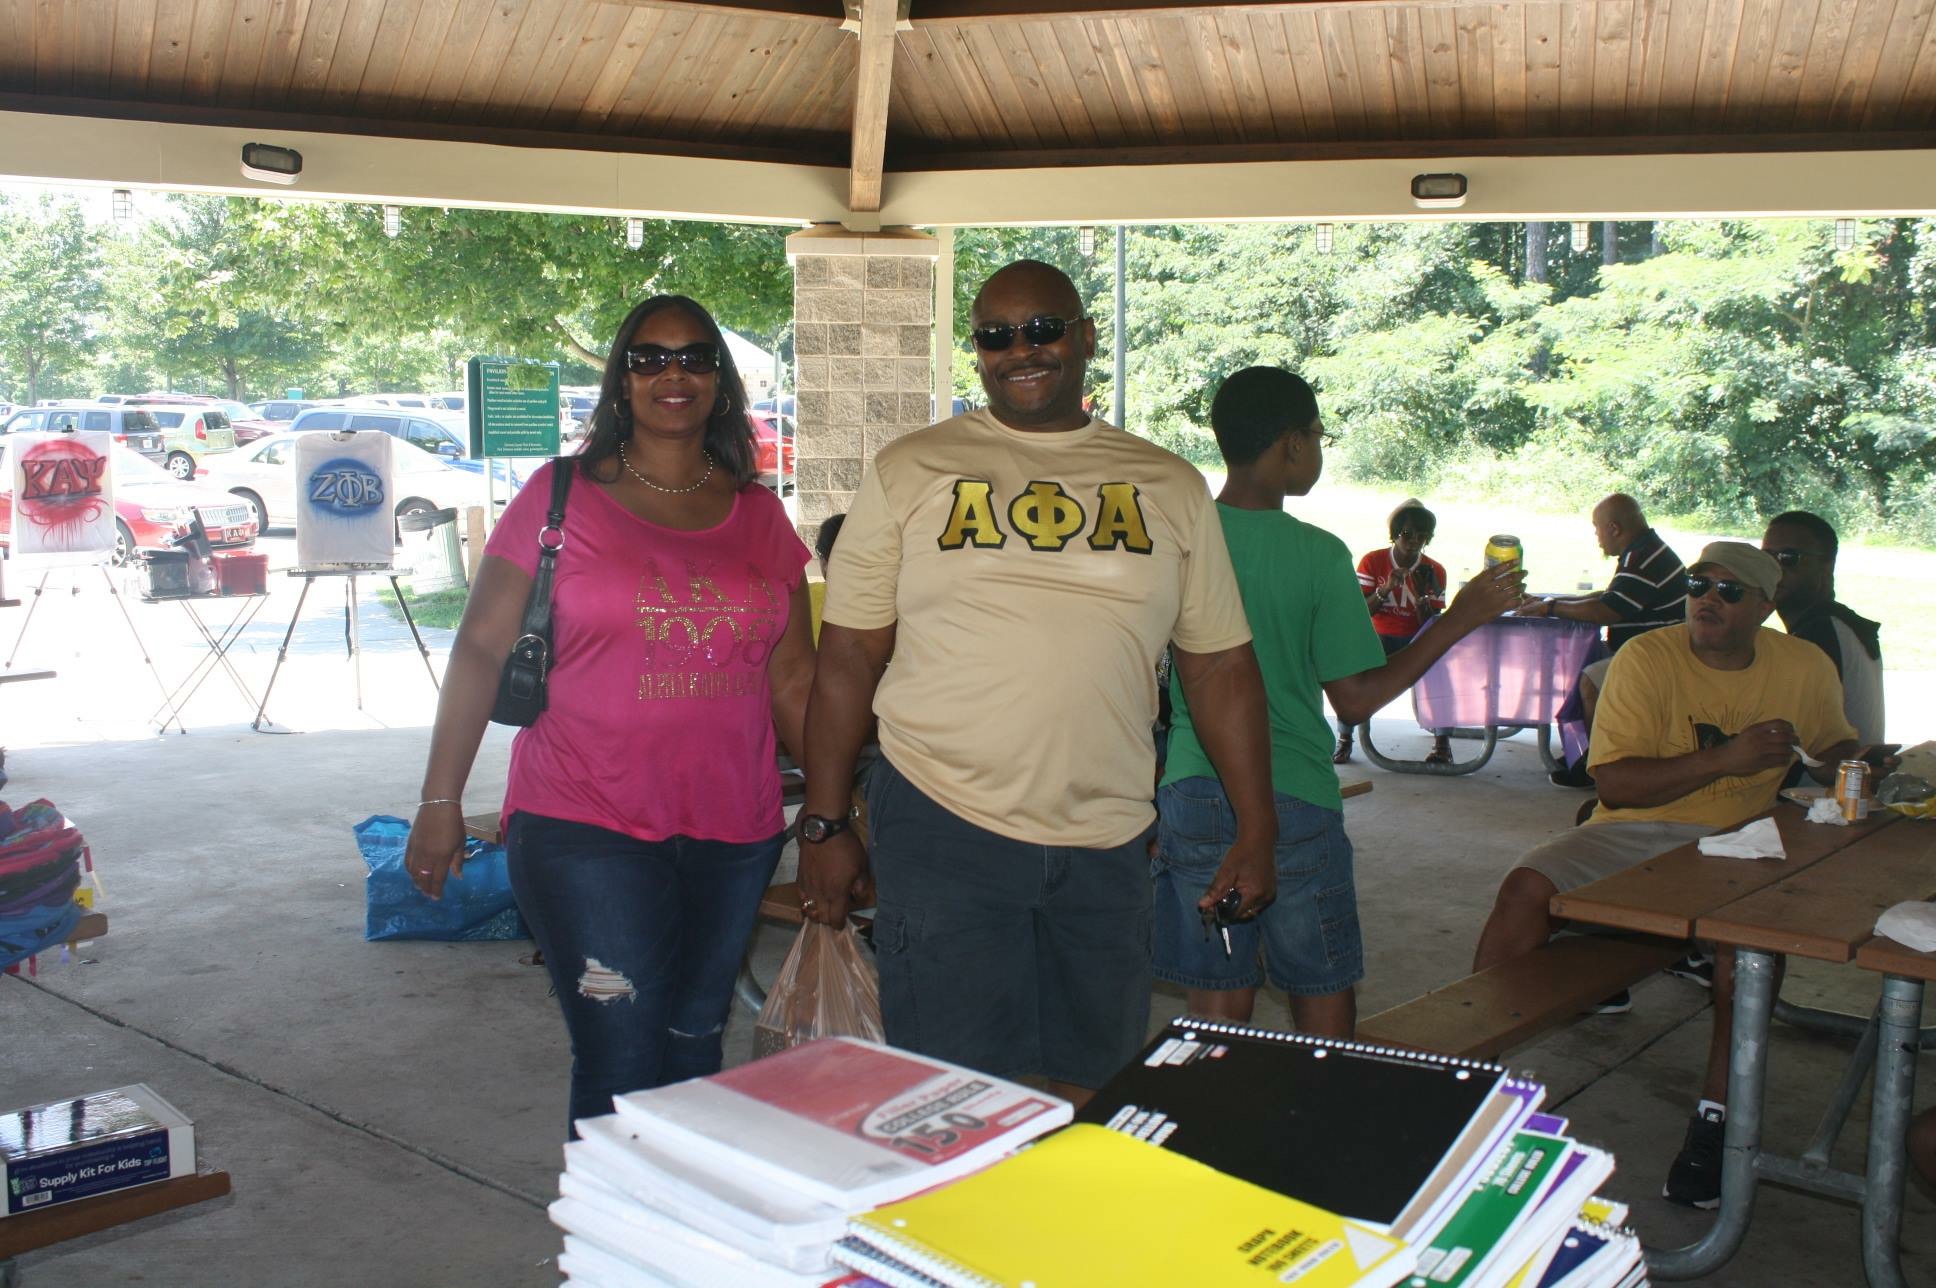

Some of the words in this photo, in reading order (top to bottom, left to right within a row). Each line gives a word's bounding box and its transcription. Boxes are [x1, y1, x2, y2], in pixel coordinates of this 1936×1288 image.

[892, 1112, 986, 1153] 150
[39, 1172, 78, 1188] Supply
[79, 1167, 96, 1180] Kit
[97, 1163, 117, 1175] For
[117, 1158, 142, 1170] Kids
